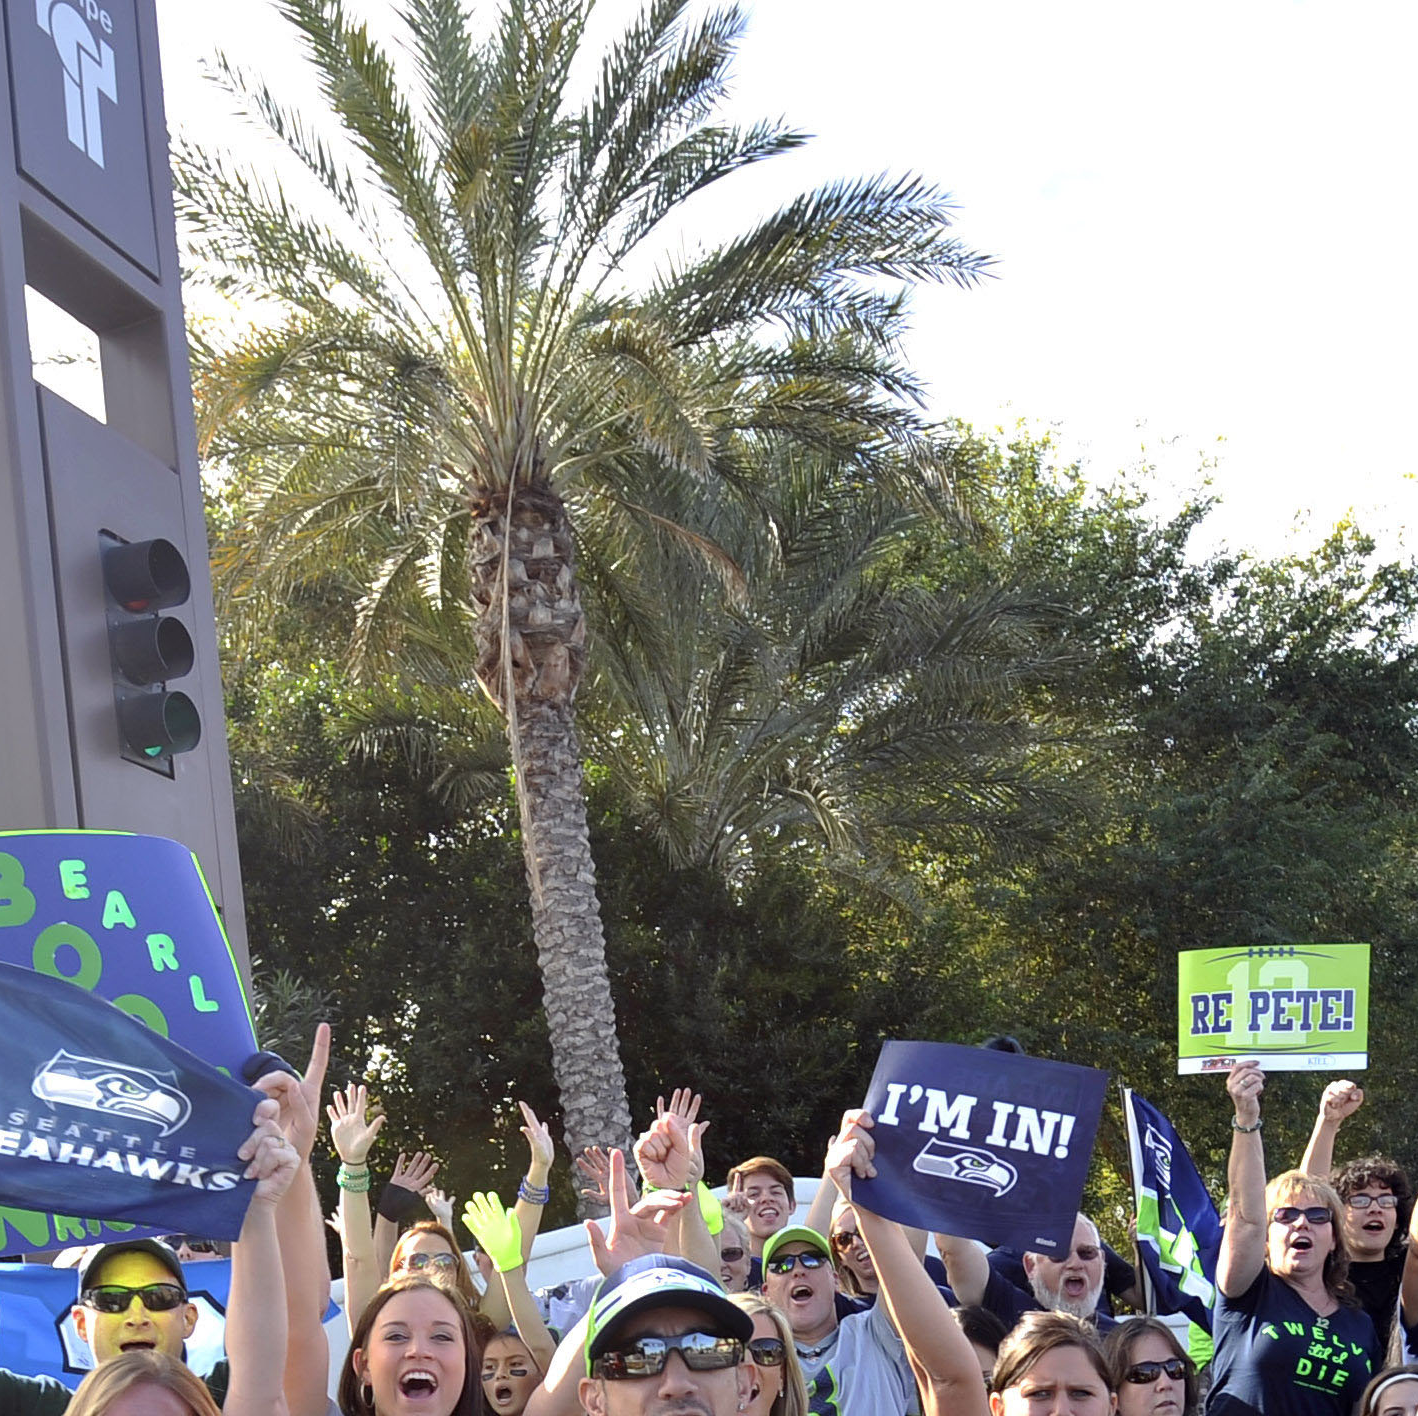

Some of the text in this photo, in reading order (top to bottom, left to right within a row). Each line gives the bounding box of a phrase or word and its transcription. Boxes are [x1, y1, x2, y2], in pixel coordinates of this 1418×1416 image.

[58, 858, 220, 1012] EARL
[1190, 988, 1356, 1036] RE PETE!
[7, 1110, 197, 1159] SEATTLE
[878, 1083, 1077, 1160] I'M IN!
[1261, 1321, 1372, 1374] TWELV
[1296, 1357, 1350, 1388] DIE
